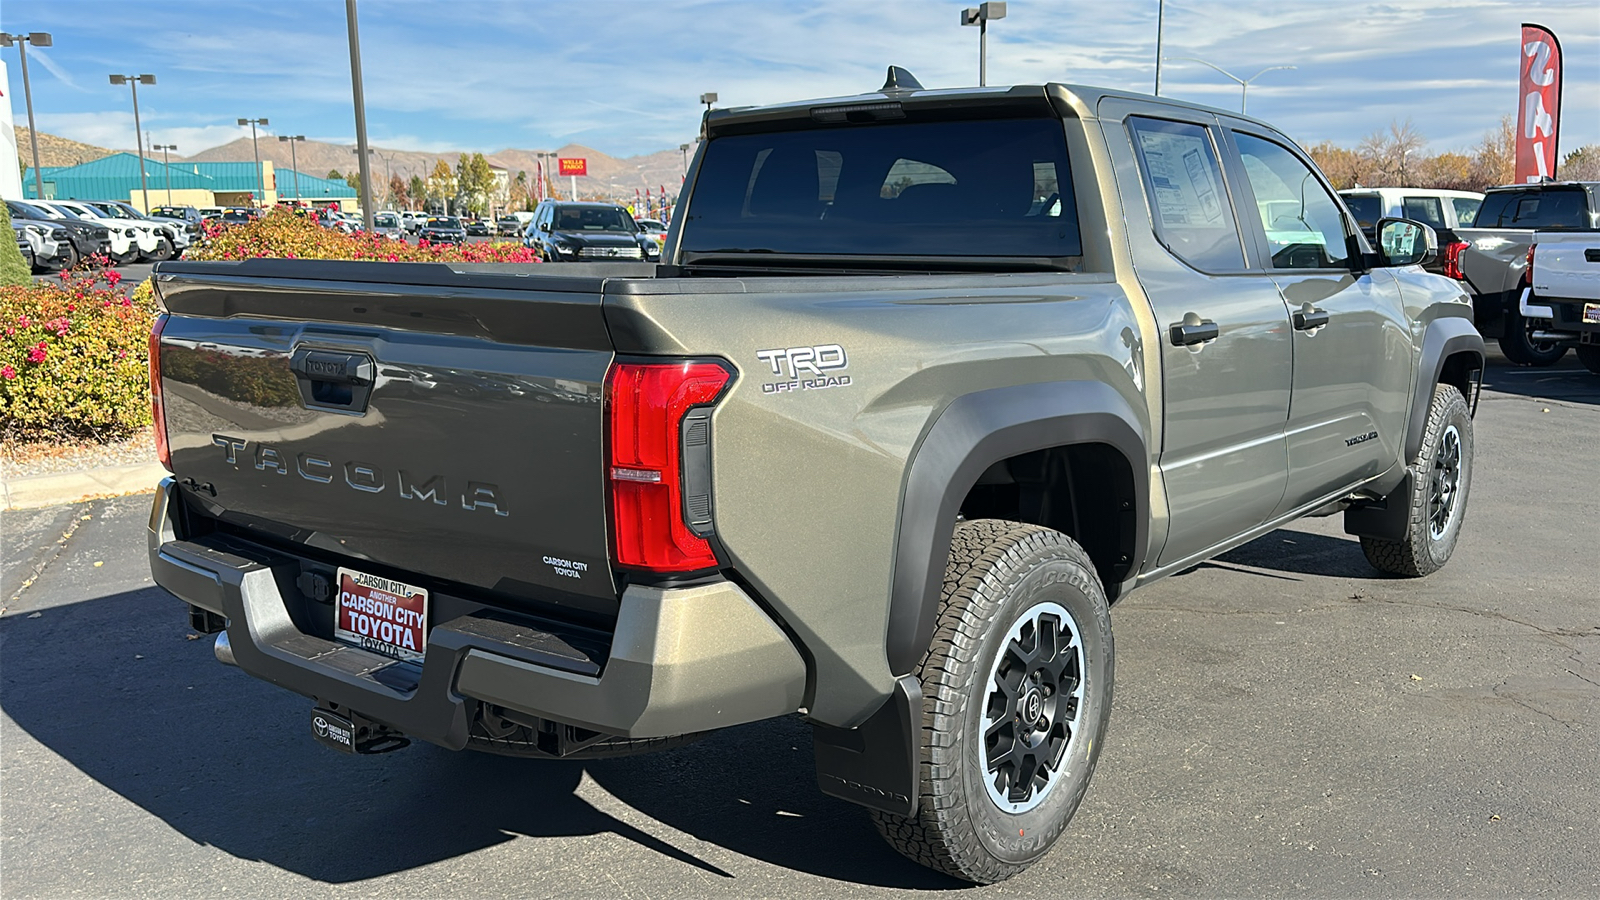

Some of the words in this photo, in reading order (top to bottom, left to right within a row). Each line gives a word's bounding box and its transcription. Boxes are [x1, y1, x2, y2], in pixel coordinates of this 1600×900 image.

[308, 361, 346, 375] TOYOTA
[756, 344, 848, 379] TRD
[762, 381, 799, 394] OFF
[802, 375, 852, 390] ROAD
[211, 433, 509, 516] TACOMA
[542, 556, 572, 568] CARSON
[572, 561, 588, 571] CITY
[554, 566, 581, 579] TOYOTA
[359, 574, 389, 591] CARSON
[390, 582, 407, 595] CITY
[369, 590, 396, 605] ANOTHER
[341, 591, 393, 620] CARSON
[395, 607, 424, 629] CITY
[348, 610, 415, 650] TOYOTA
[359, 635, 400, 658] TOYOTA
[329, 731, 350, 745] TOYOTA
